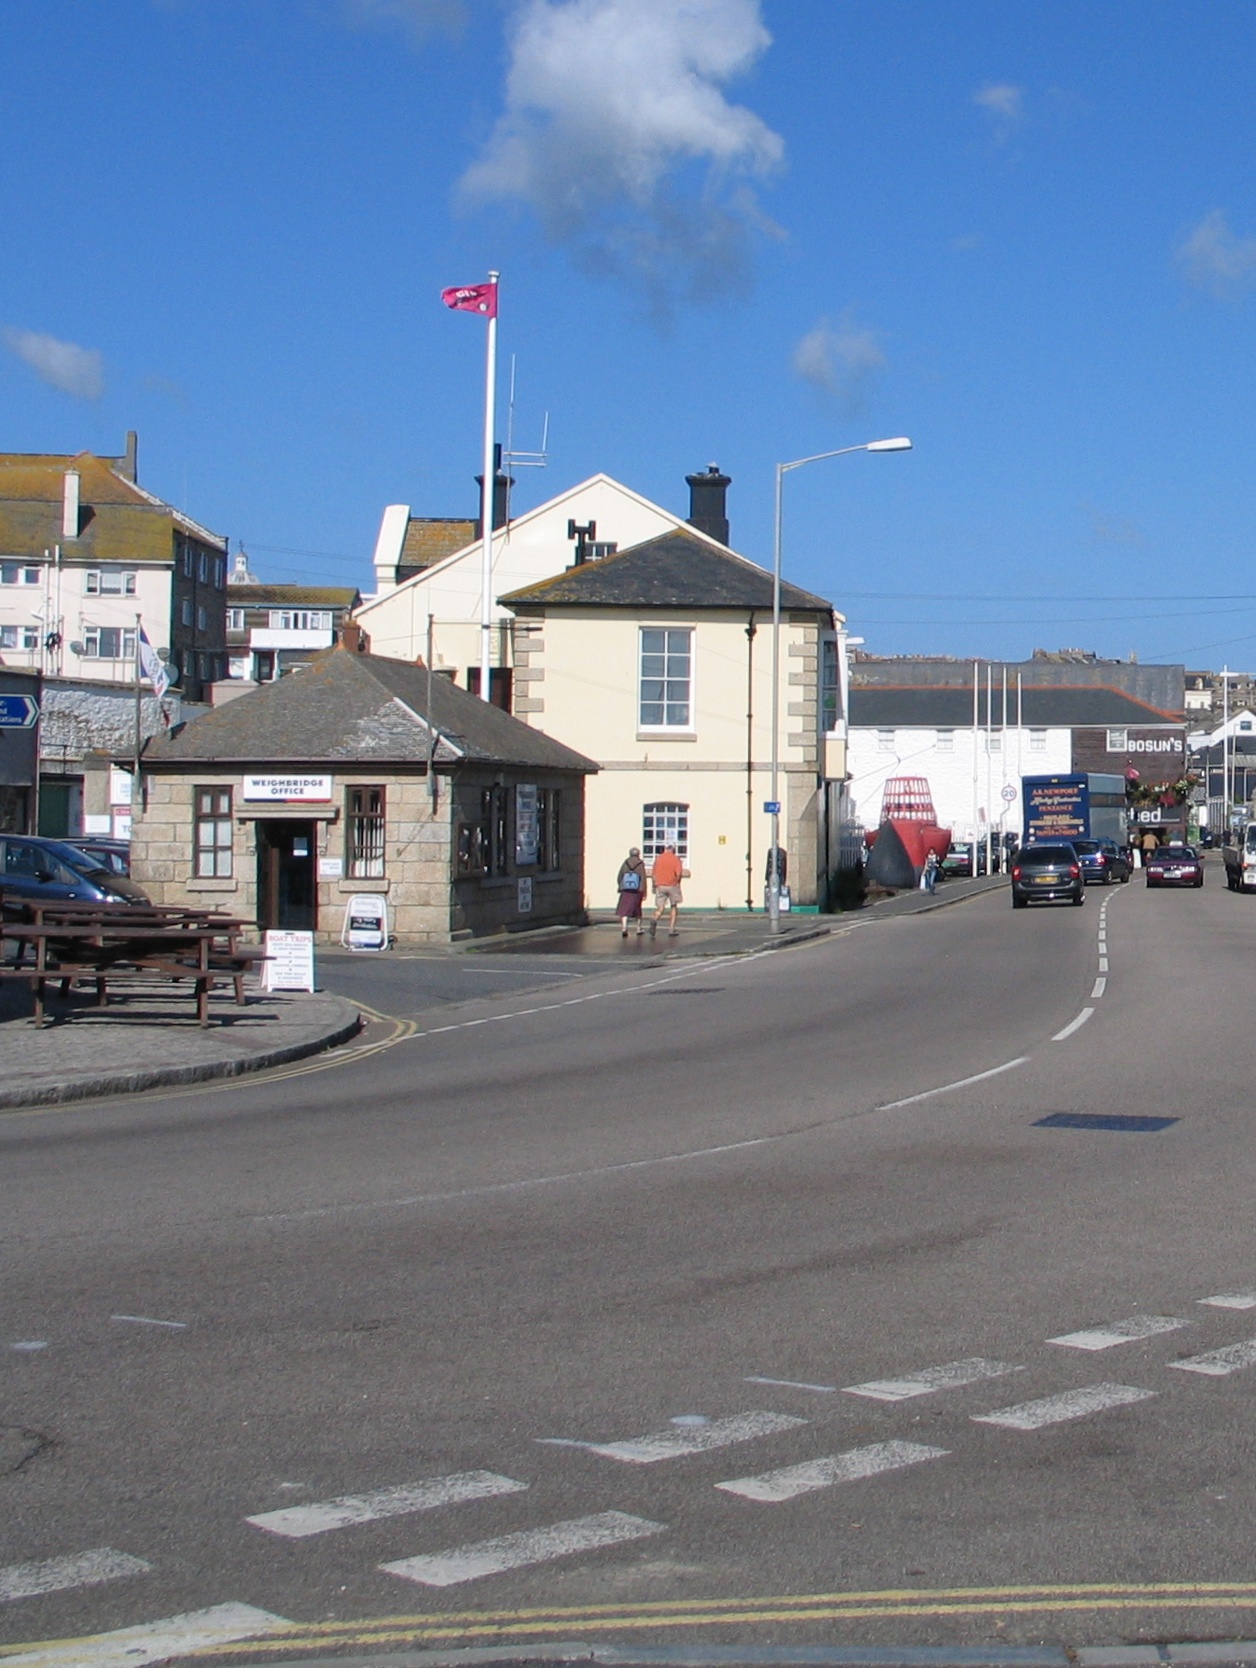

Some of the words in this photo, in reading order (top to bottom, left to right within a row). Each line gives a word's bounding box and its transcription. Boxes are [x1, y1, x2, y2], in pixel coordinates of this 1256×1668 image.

[1128, 737, 1183, 752] BOSUN'S
[252, 779, 324, 787] WEIGHBRIDGE
[1003, 789, 1015, 797] 20
